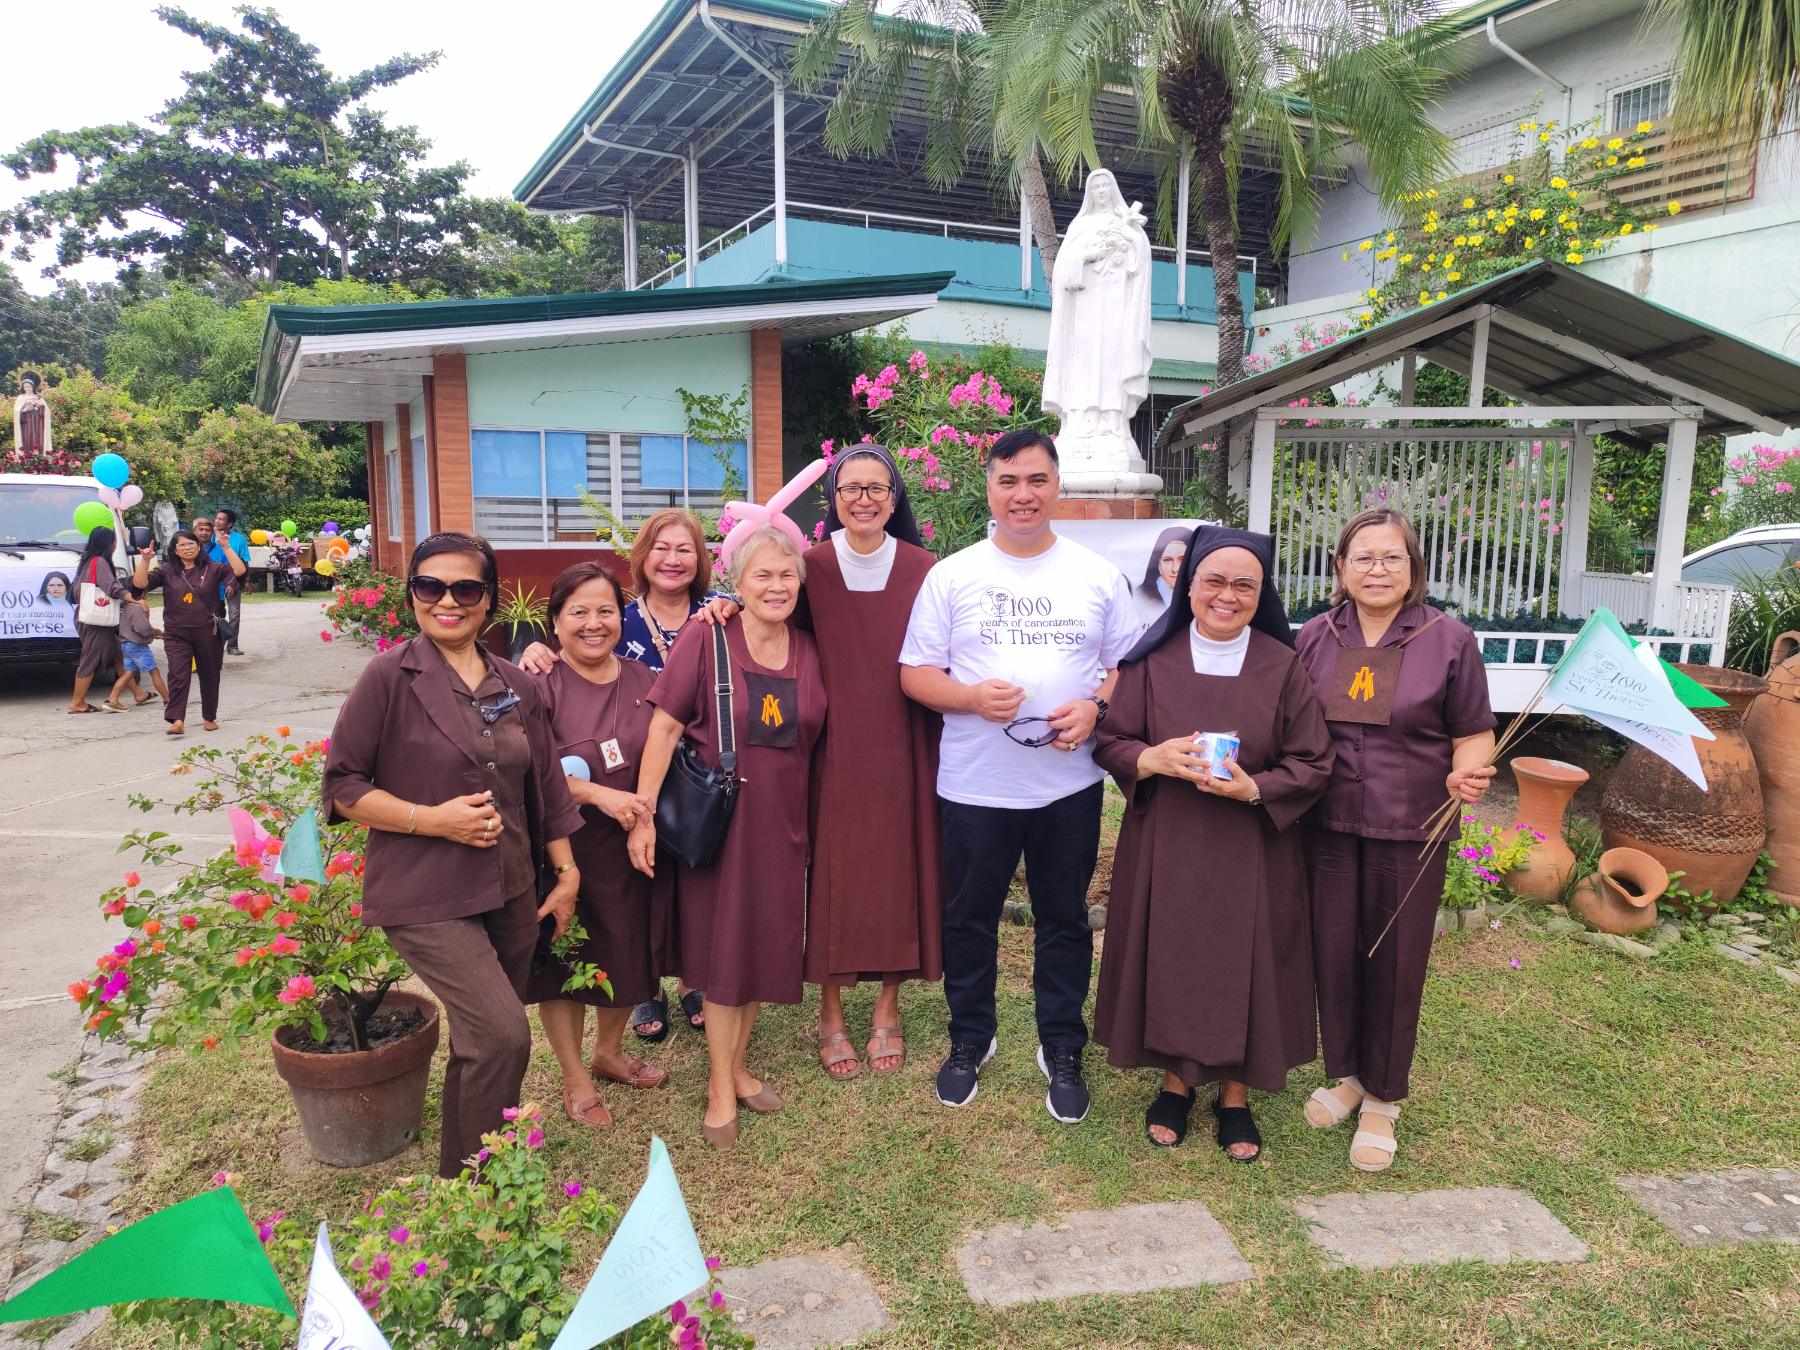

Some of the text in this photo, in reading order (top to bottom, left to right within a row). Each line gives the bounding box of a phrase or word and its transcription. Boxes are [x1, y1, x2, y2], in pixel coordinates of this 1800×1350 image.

[1011, 597, 1052, 617] 100
[980, 618, 1087, 629] years of canonization
[980, 628, 1002, 646] St.
